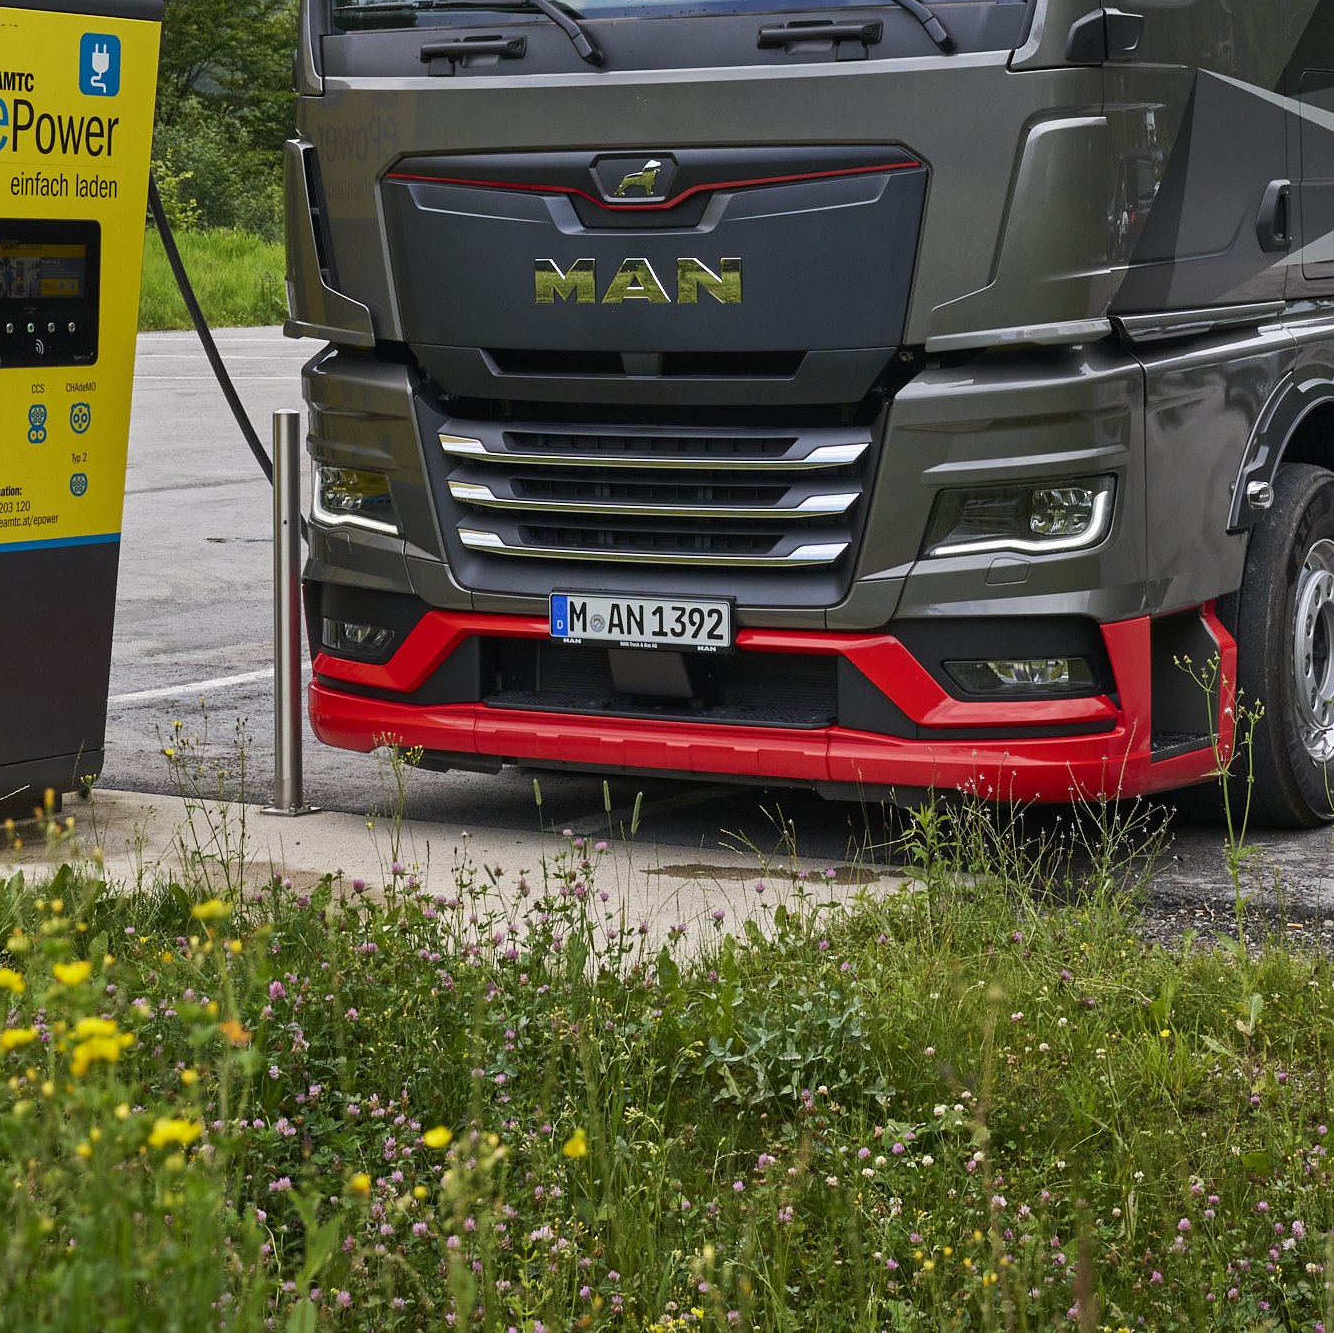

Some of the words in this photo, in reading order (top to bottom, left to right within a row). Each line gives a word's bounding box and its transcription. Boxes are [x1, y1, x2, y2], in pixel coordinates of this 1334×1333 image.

[10, 171, 68, 197] einfach
[75, 173, 117, 198] laden
[535, 257, 742, 304] MAN
[31, 383, 45, 394] CCS
[66, 382, 97, 393] CHAdeMO
[71, 453, 81, 464] Typ
[82, 452, 87, 462] 2
[16, 500, 31, 513] 120
[556, 619, 564, 630] D
[570, 601, 586, 632] M
